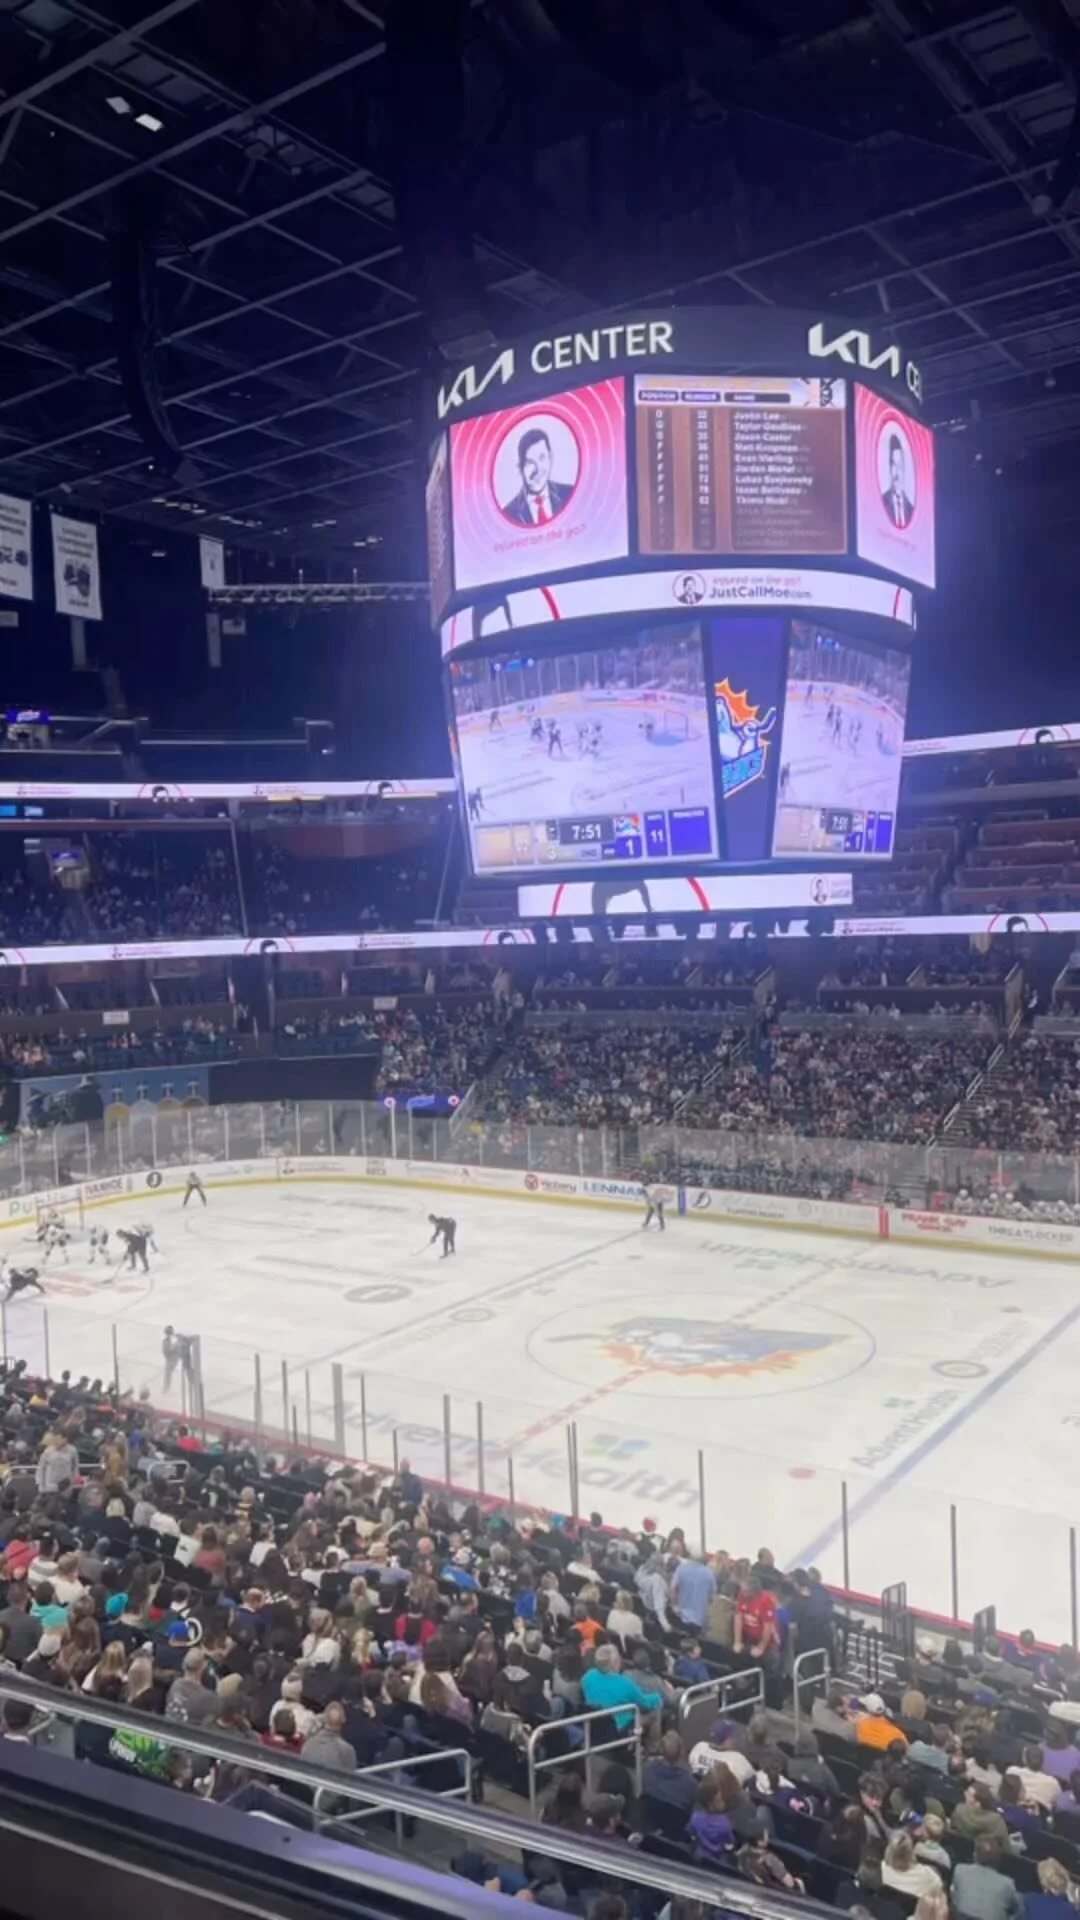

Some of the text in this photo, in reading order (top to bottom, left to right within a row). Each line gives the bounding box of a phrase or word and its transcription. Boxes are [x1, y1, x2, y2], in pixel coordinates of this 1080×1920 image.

[530, 321, 674, 374] CENTER
[571, 823, 602, 842] 7:51
[651, 829, 665, 844] 11
[625, 838, 635, 856] 1
